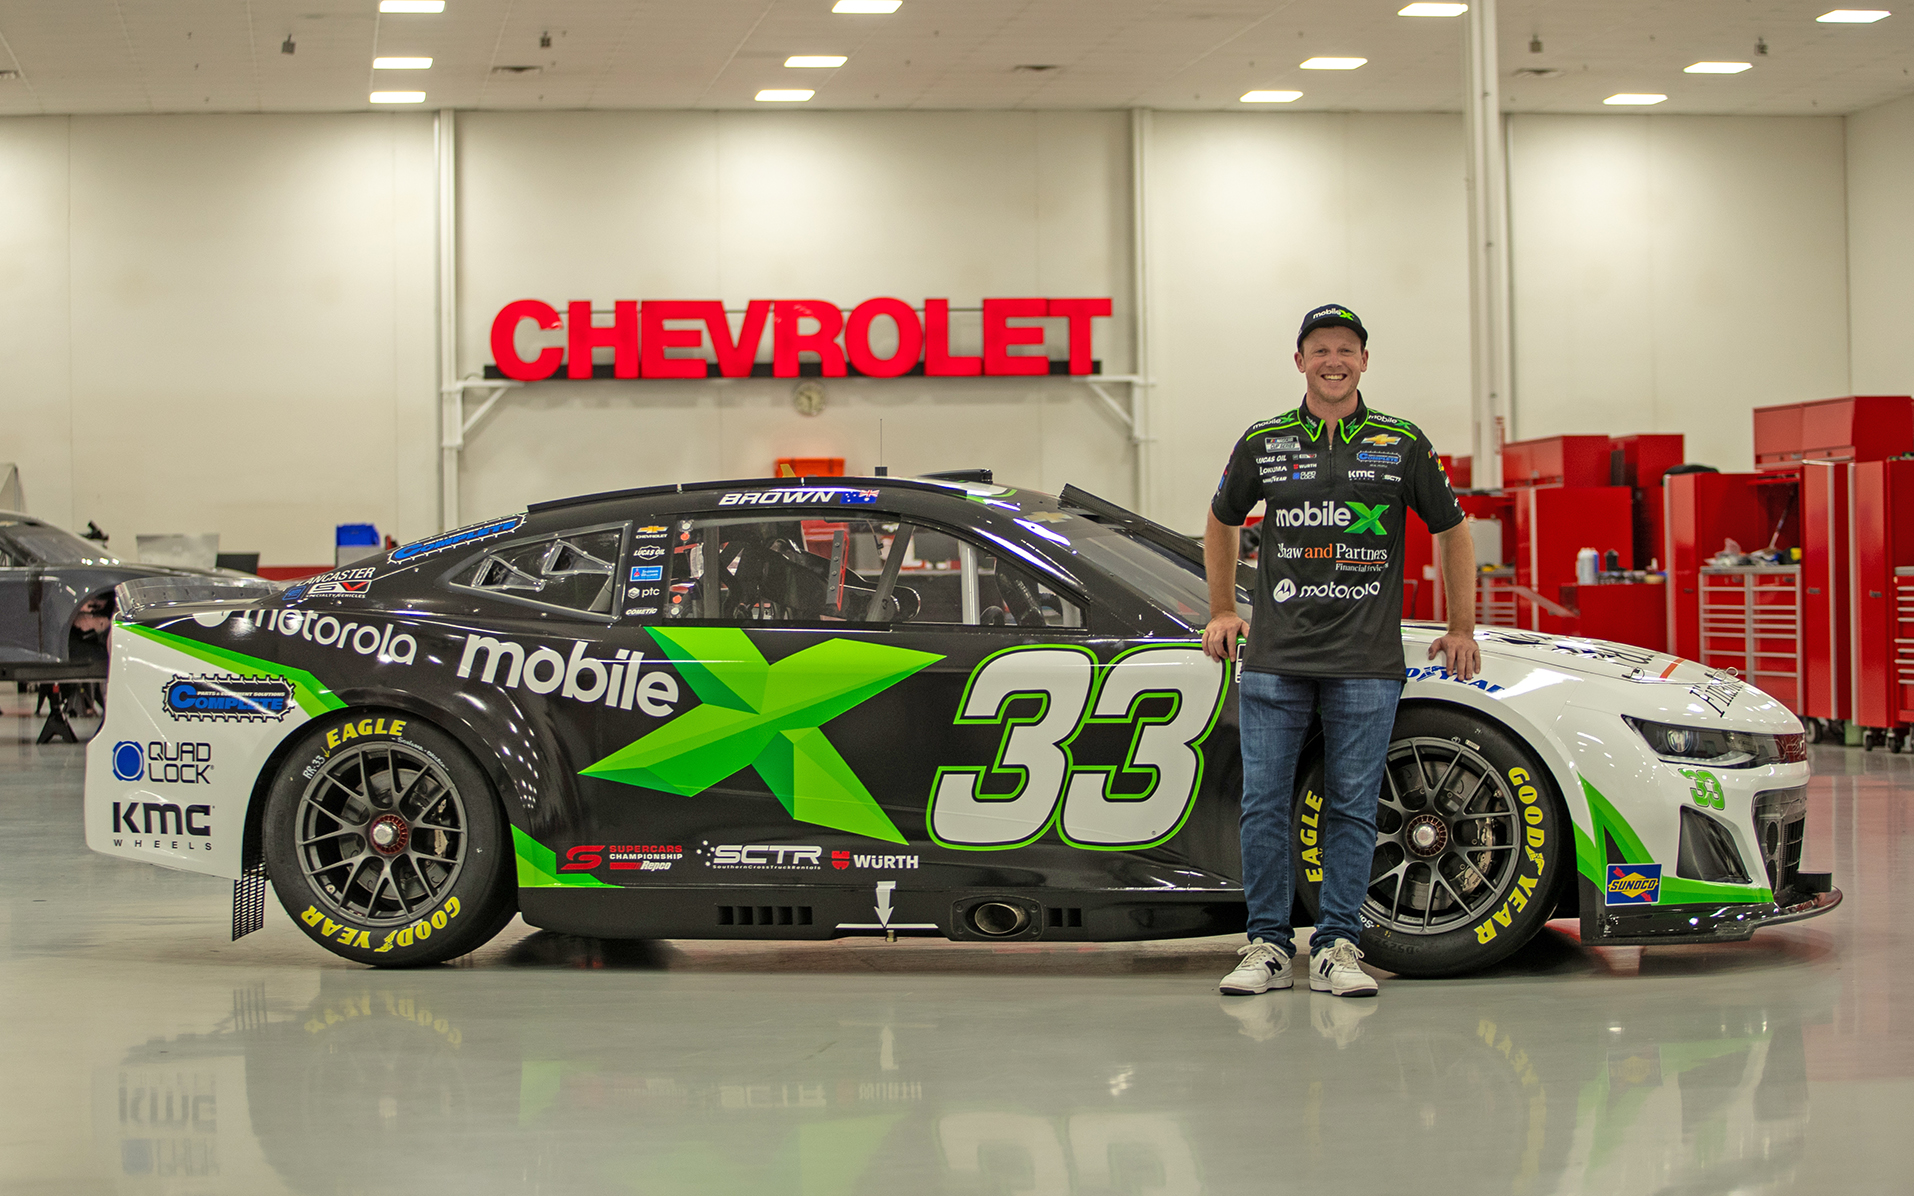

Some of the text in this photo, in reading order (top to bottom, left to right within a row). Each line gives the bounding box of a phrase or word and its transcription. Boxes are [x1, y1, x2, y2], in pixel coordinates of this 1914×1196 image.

[490, 298, 1113, 381] CHEVROLET
[718, 491, 835, 505] BROWN
[394, 520, 517, 559] COMPLETE
[1304, 543, 1333, 559] and
[296, 567, 376, 587] LANCASTER
[641, 587, 660, 598] ptc
[1299, 581, 1381, 600] motorola
[243, 609, 418, 665] motorola
[171, 684, 284, 709] COMPLETE
[326, 718, 407, 750] EAGLE
[148, 741, 211, 762] QUAD
[926, 643, 1231, 851] 33
[148, 763, 211, 784] LOCK
[1678, 768, 1725, 811] 33
[113, 839, 213, 851] WHEELS
[1300, 790, 1324, 882] EAGLE
[609, 845, 683, 853] SUPERCARS
[713, 845, 823, 864] SCTR
[640, 860, 672, 871] Repco
[1609, 880, 1657, 890] SUNOCO
